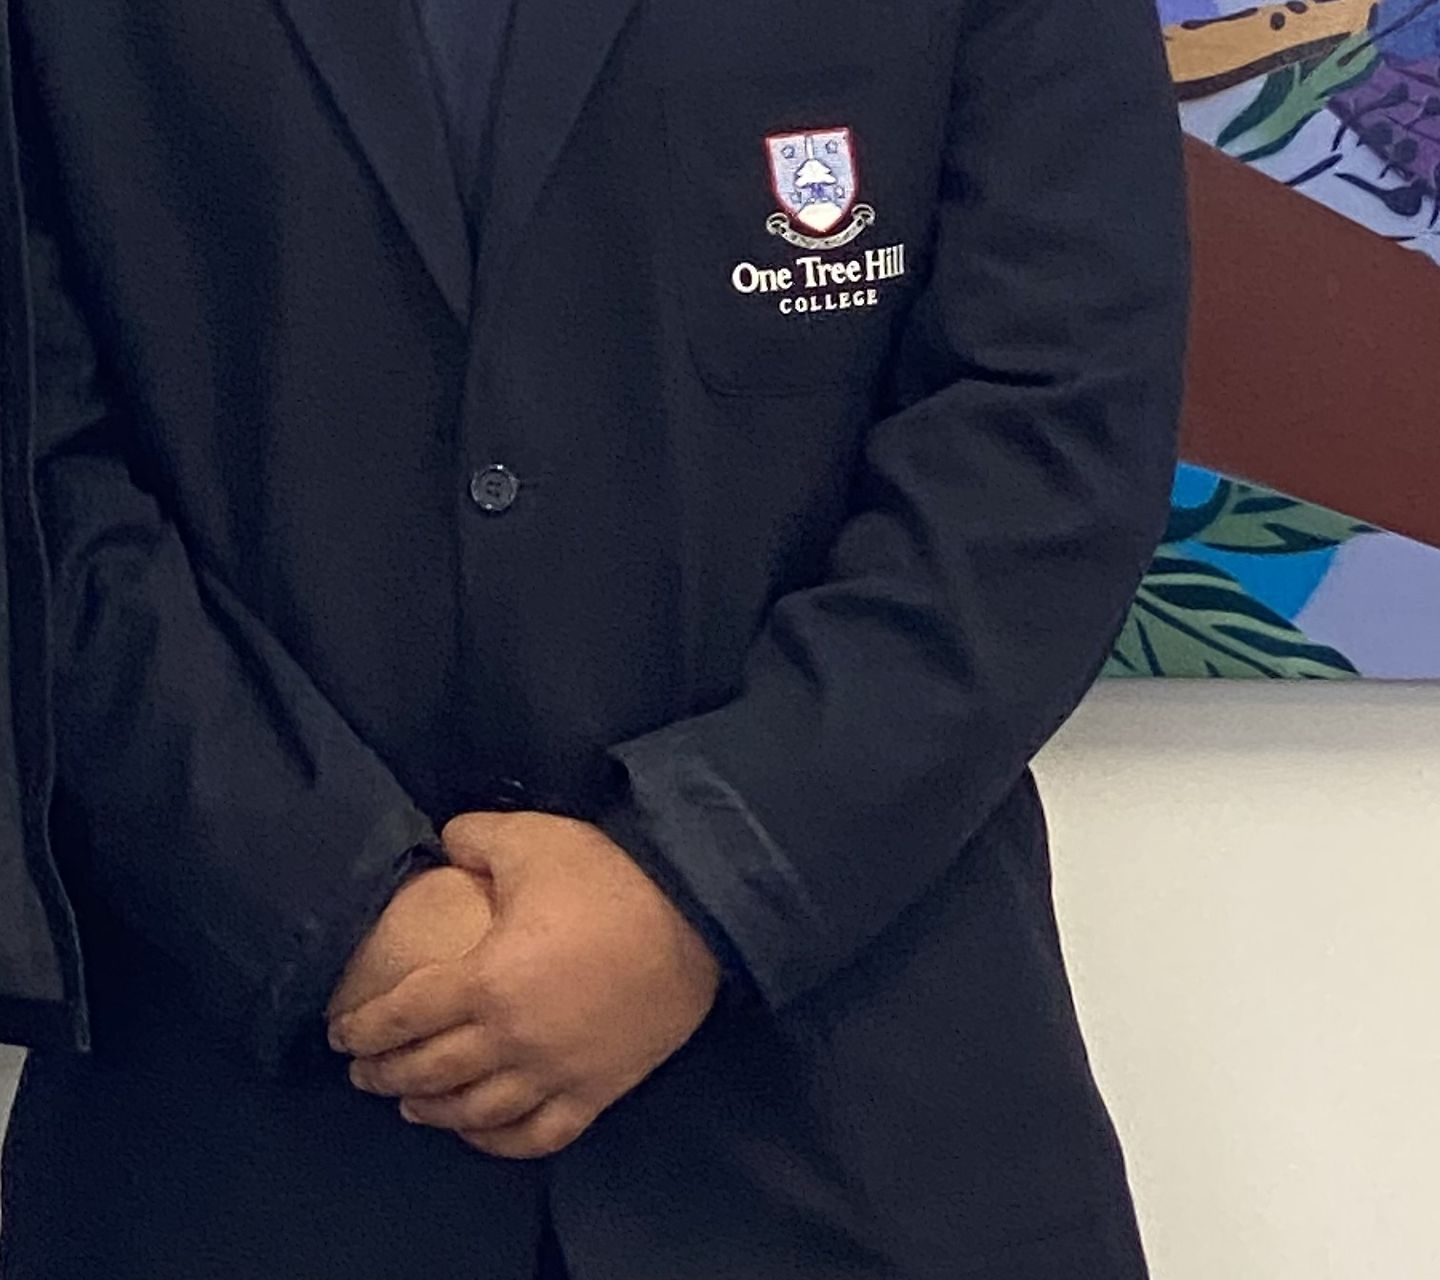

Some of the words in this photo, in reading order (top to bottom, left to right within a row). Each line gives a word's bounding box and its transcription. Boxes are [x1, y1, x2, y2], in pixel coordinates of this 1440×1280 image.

[731, 262, 793, 294] One
[796, 256, 861, 288] Tree
[864, 243, 905, 281] Hill
[778, 288, 878, 315] COLLEGE
